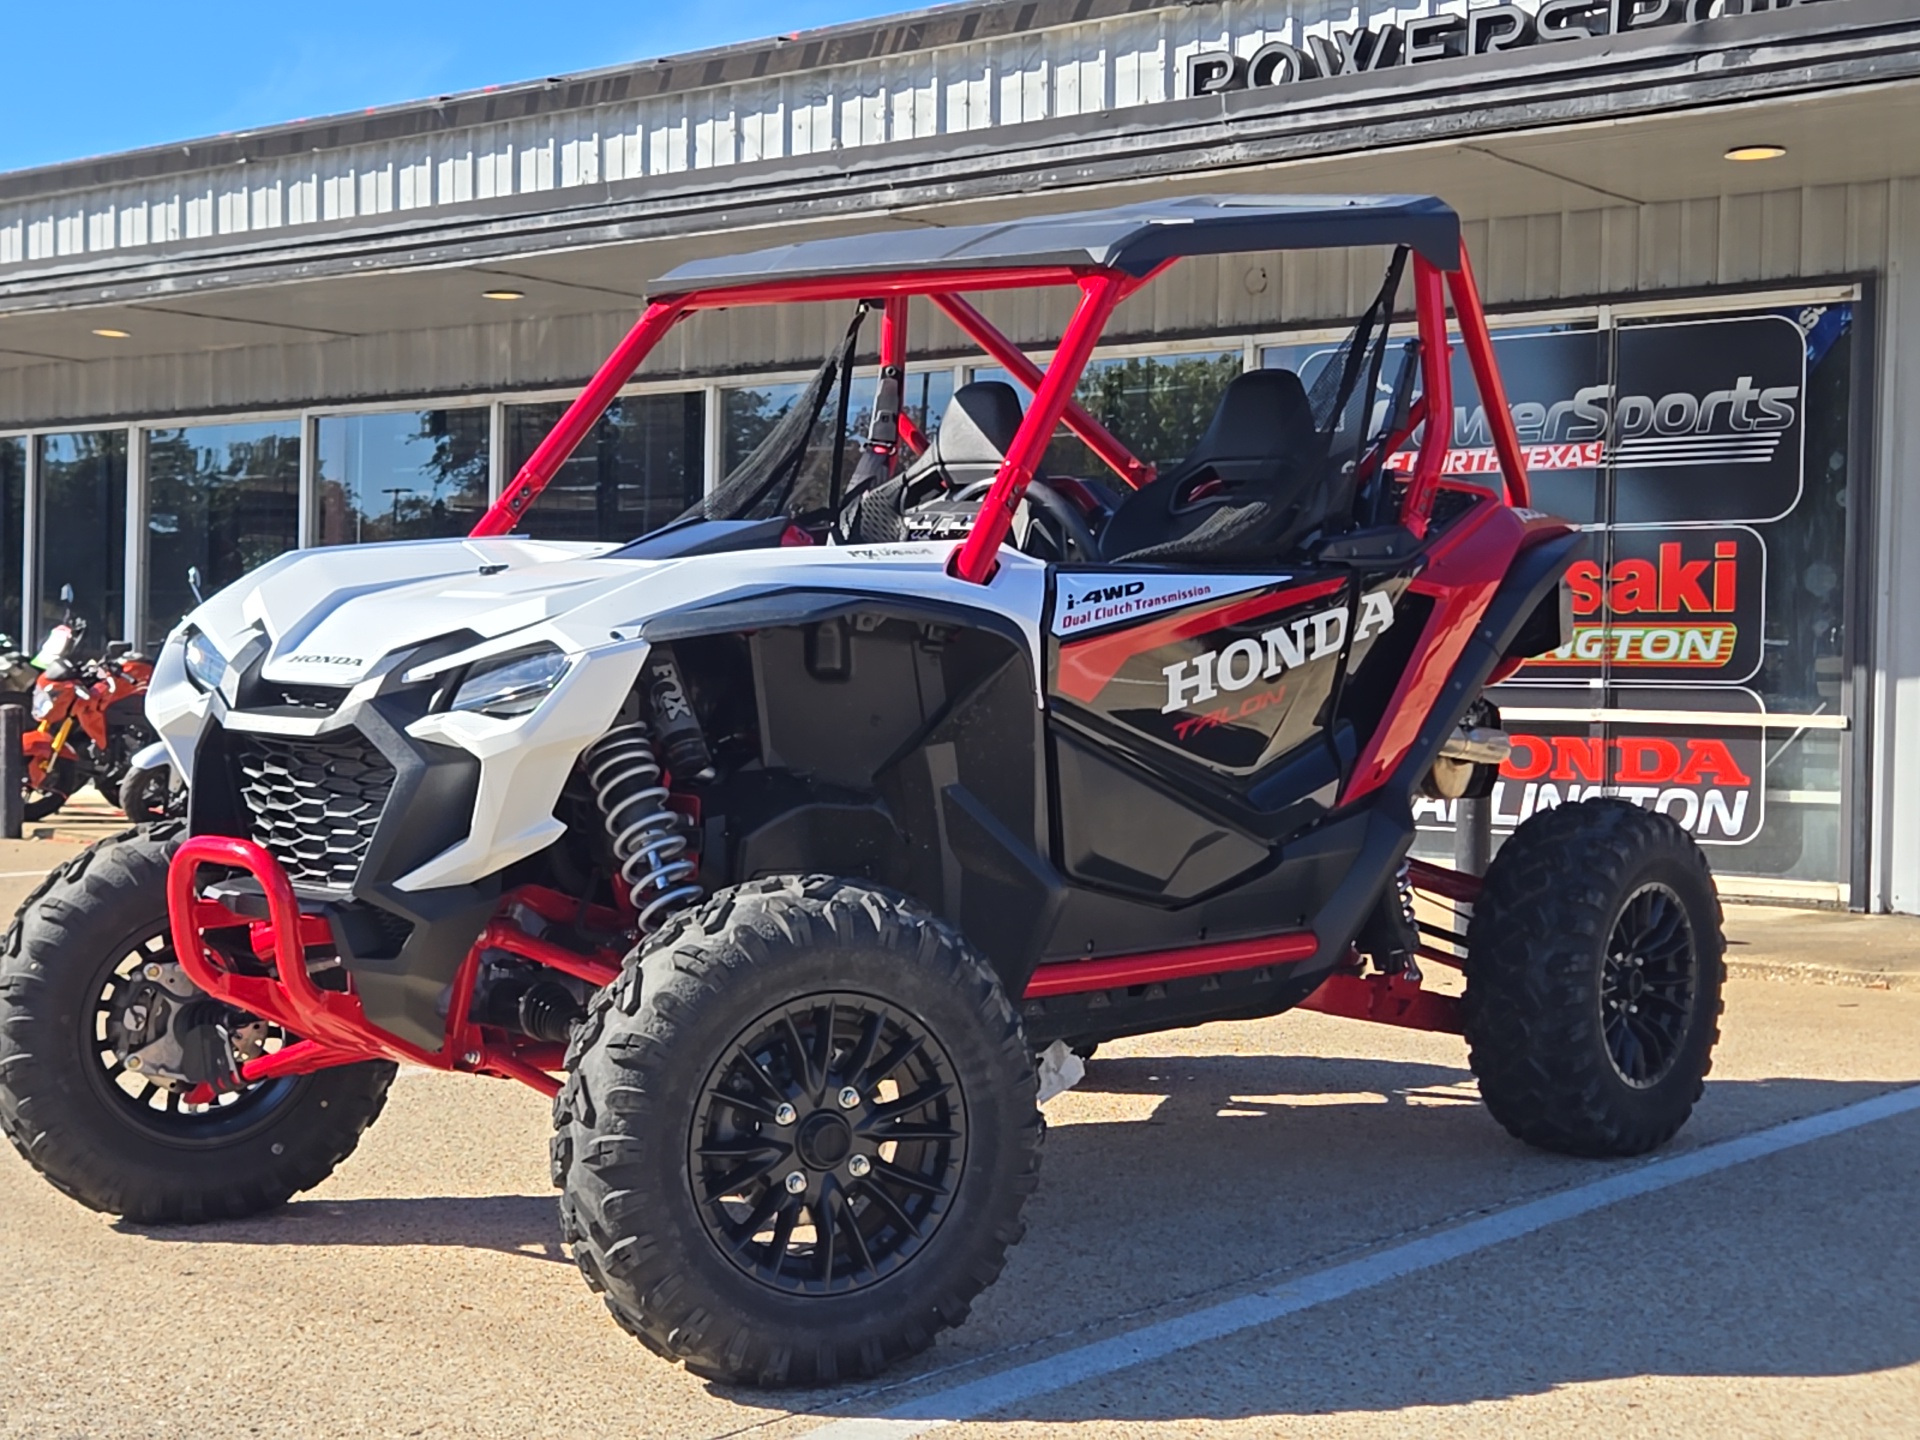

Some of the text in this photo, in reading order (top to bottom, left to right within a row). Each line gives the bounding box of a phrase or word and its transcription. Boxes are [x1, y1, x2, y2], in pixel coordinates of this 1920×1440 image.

[1187, 0, 1798, 97] POWERSP
[1366, 376, 1799, 449] werSports
[1405, 450, 1500, 473] RTH
[1062, 585, 1211, 629] Dual Clutch Transmission
[1067, 581, 1145, 610] i-4WD
[286, 655, 364, 667] HONDA
[1161, 590, 1394, 715] HONDA
[651, 662, 692, 721] FOX
[1172, 684, 1288, 741] TALON
[1411, 781, 1749, 836] ALITON
